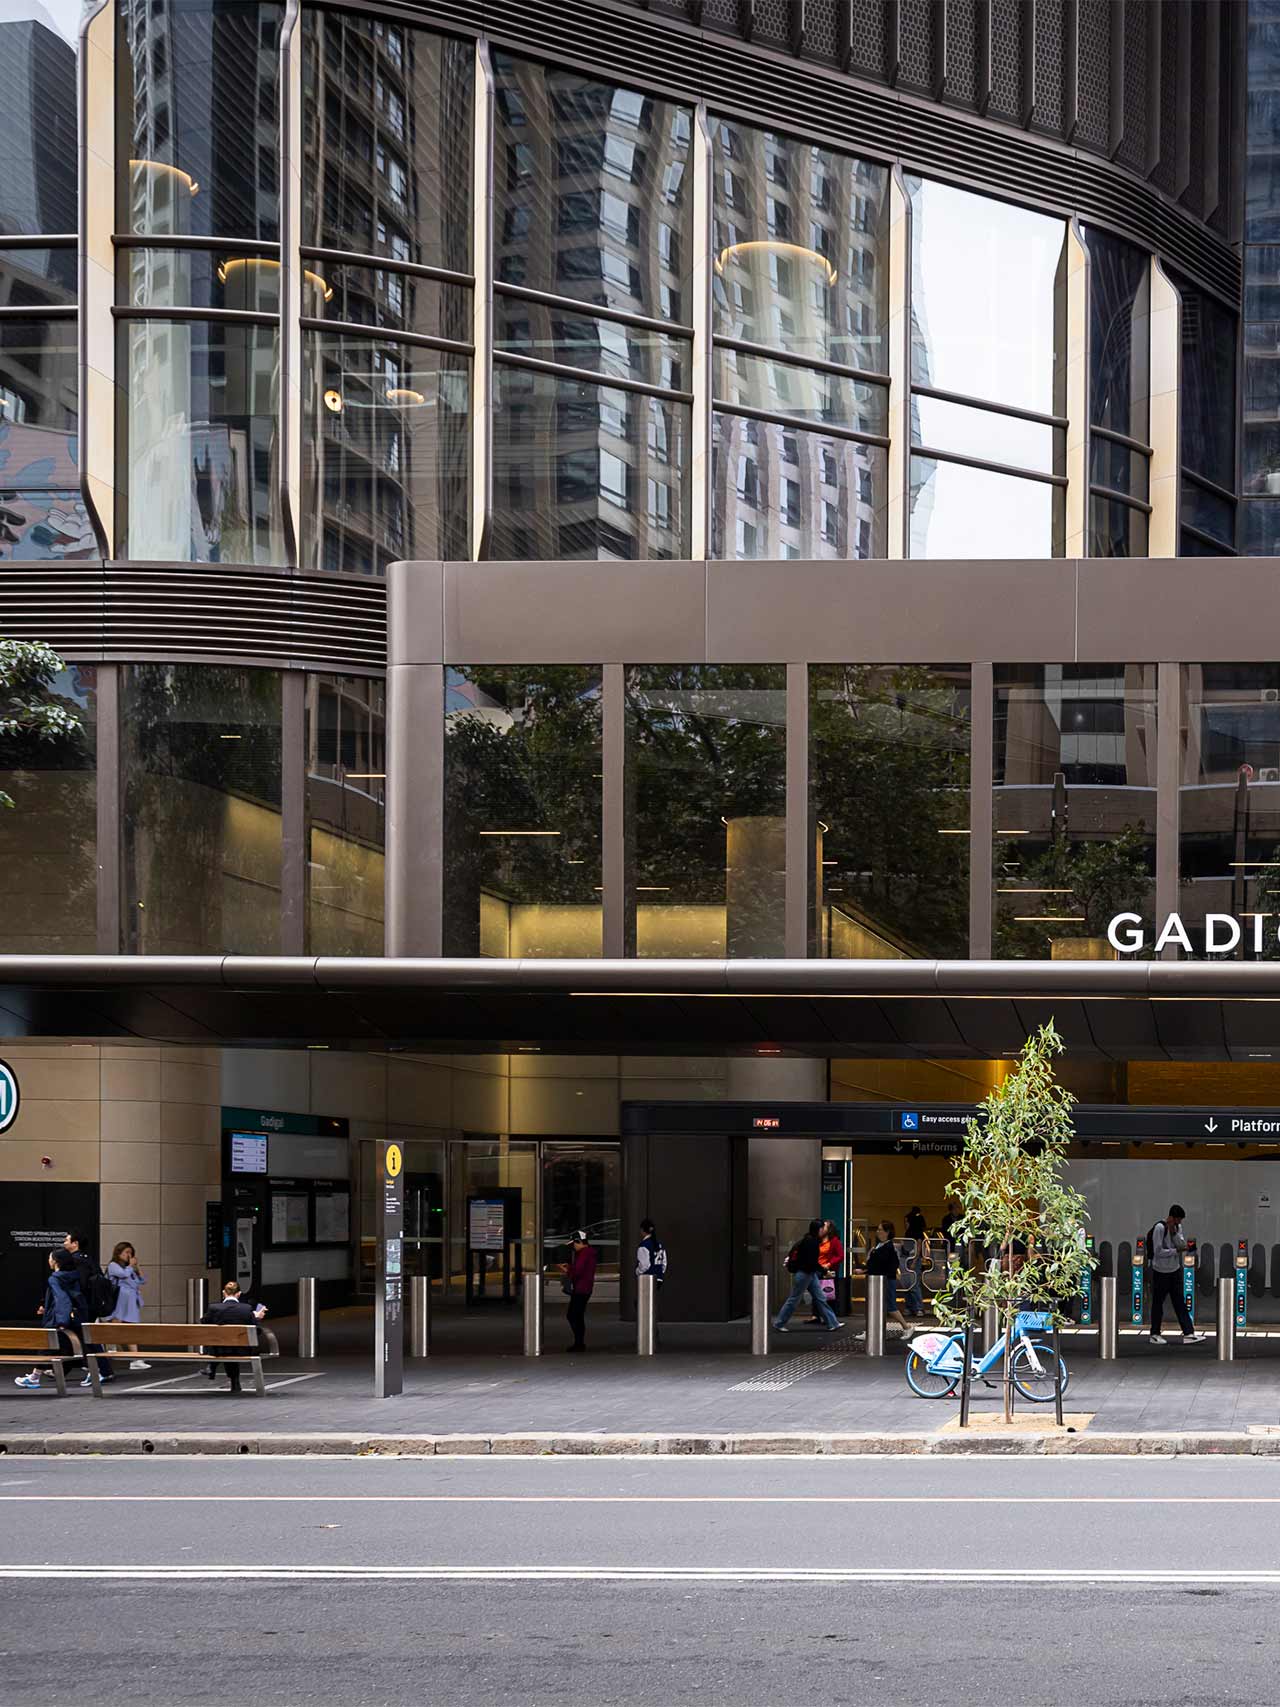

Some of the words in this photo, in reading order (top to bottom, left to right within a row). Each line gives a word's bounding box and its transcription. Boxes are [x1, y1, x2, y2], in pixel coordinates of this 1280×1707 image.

[922, 1115, 937, 1124] Easy
[912, 1142, 958, 1152] Platforms
[823, 1184, 842, 1192] HELP
